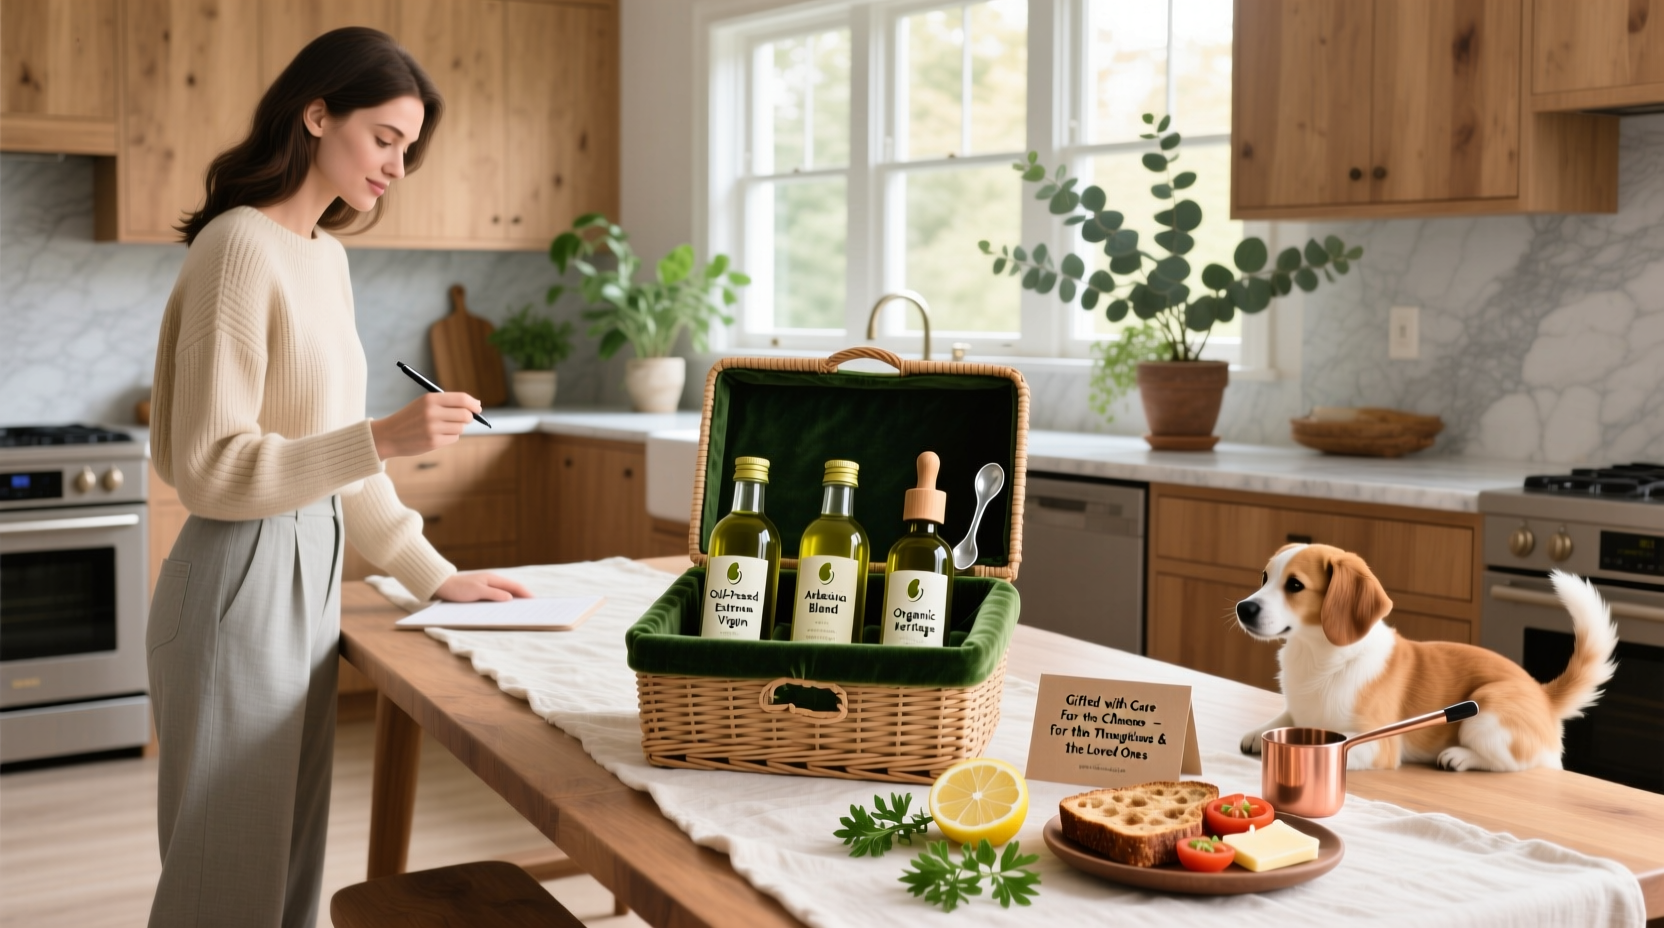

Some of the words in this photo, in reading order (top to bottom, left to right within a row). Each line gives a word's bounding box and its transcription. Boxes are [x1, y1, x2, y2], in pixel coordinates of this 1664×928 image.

[1065, 694, 1101, 708] Gifted
[1104, 696, 1127, 709] with
[1129, 699, 1157, 713] Care
[1157, 732, 1167, 745] &
[1065, 741, 1084, 754] the
[1120, 746, 1148, 760] Ones
